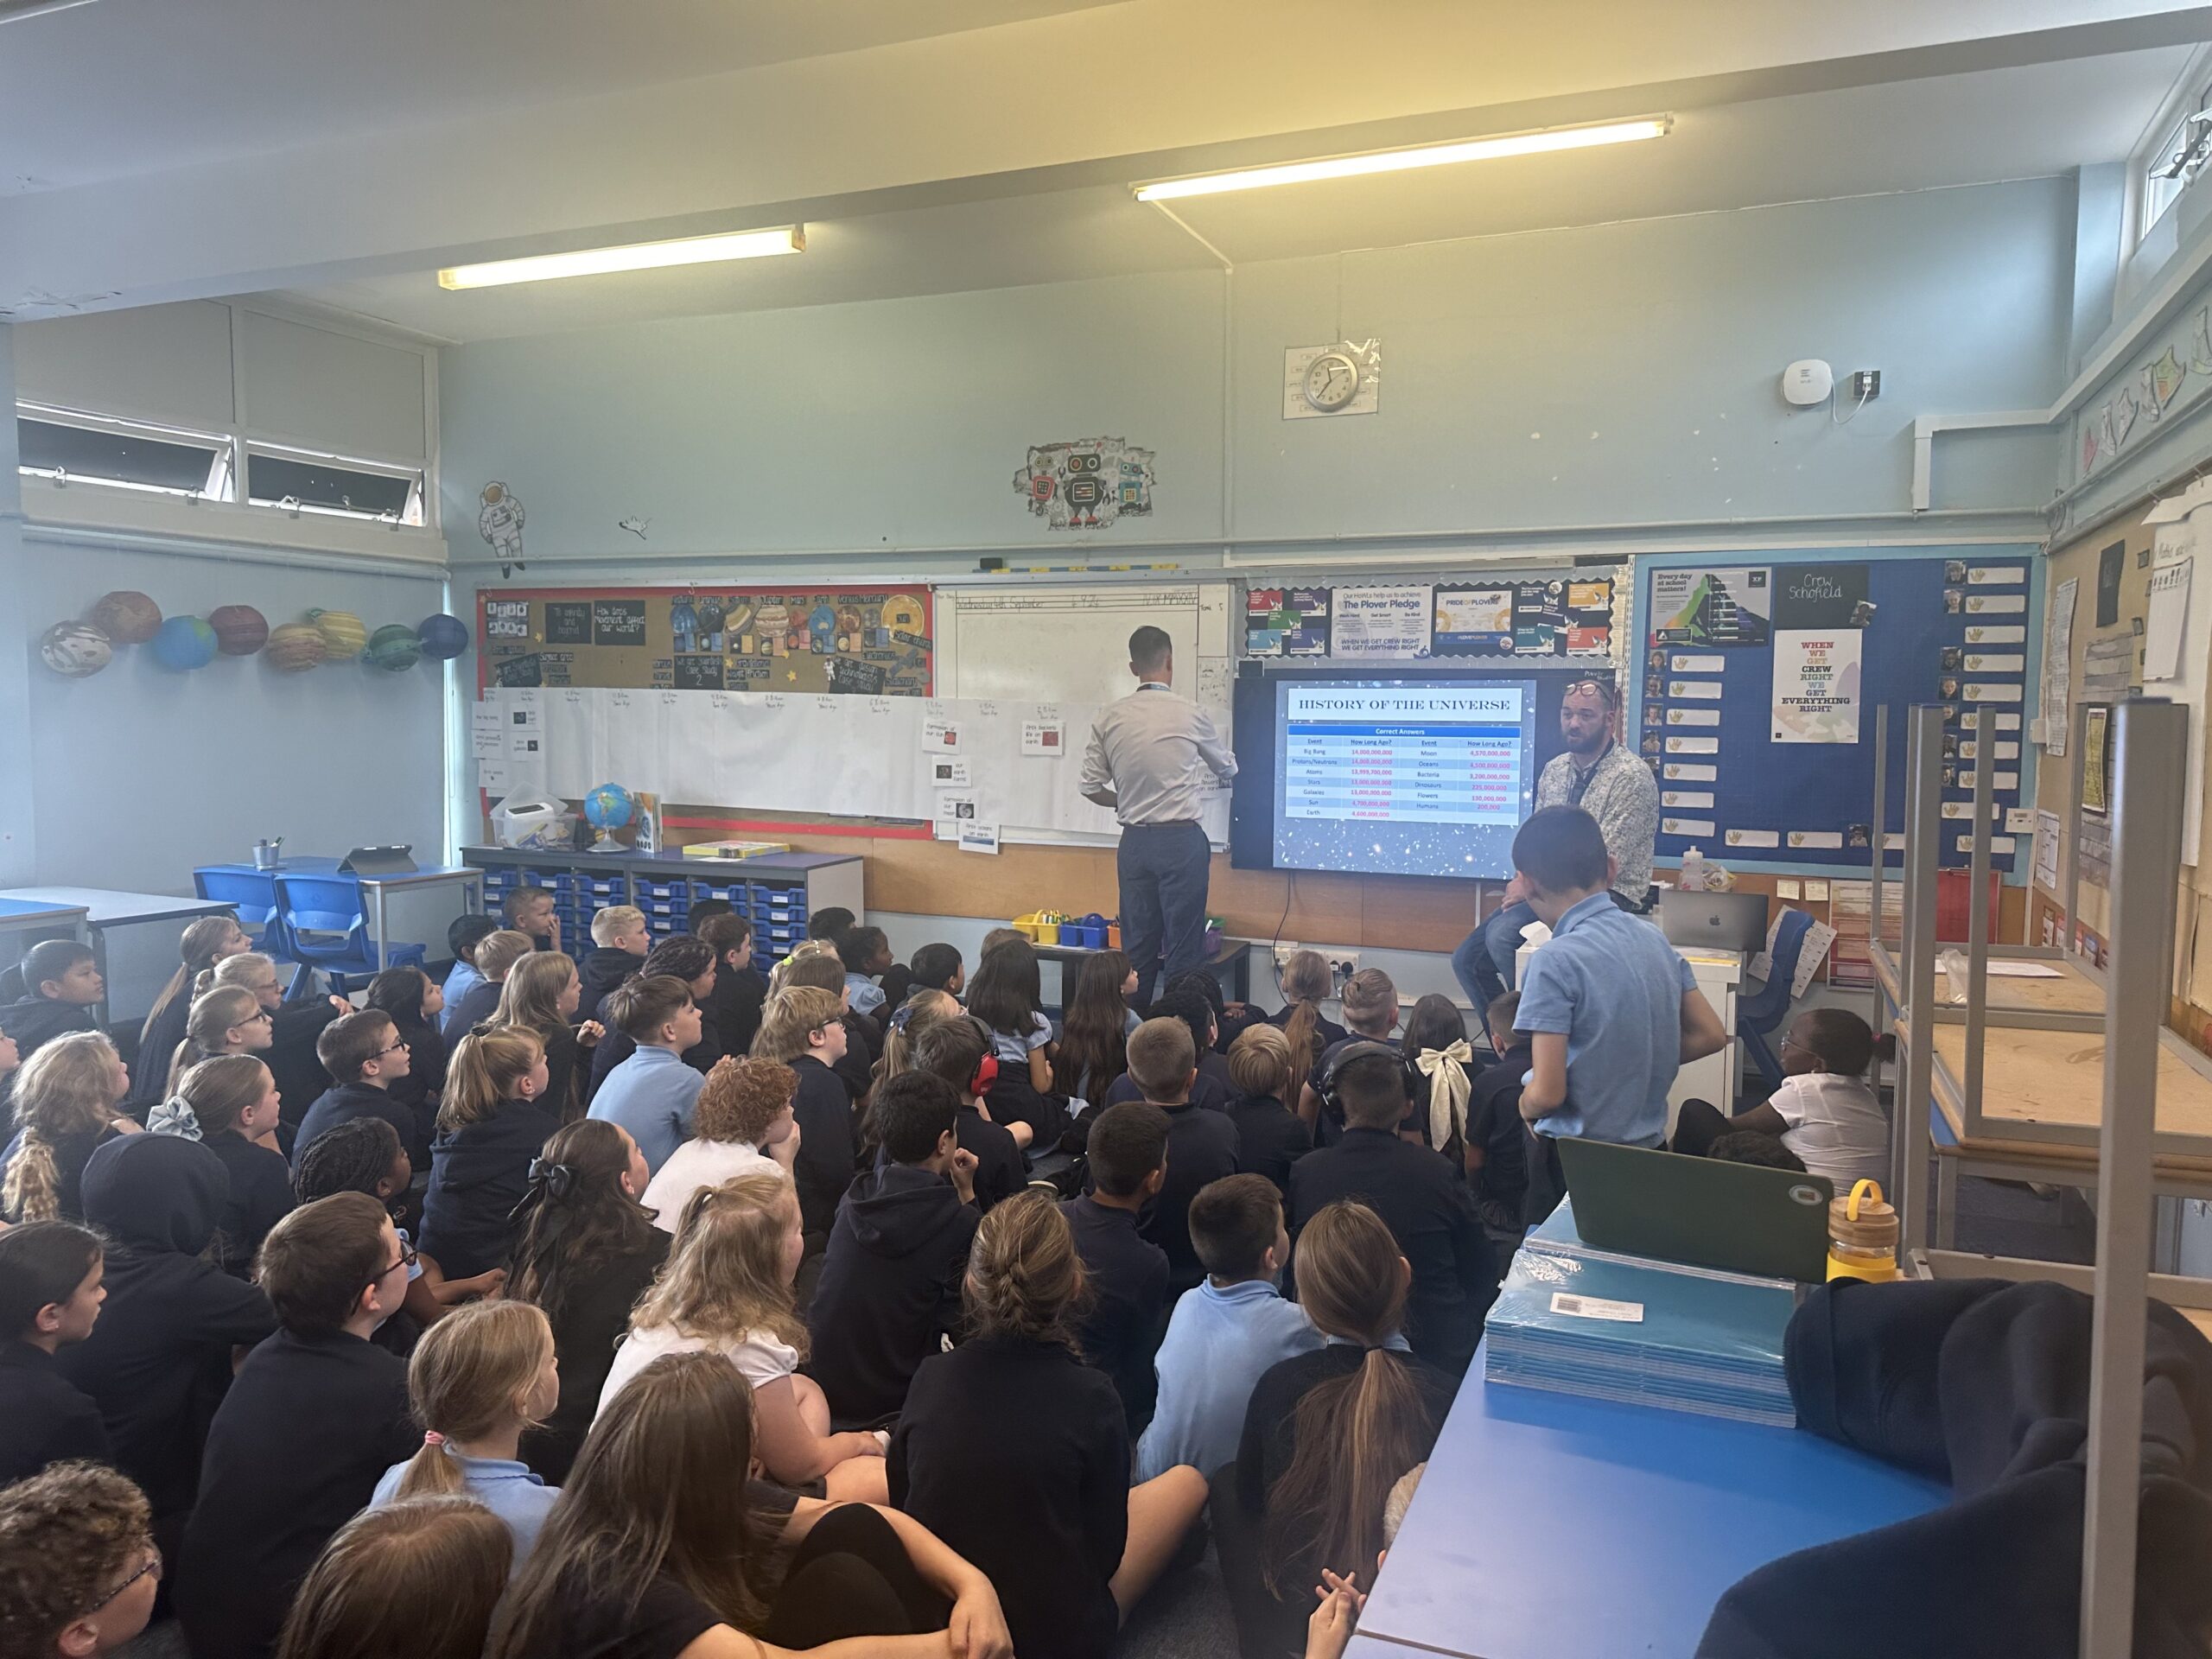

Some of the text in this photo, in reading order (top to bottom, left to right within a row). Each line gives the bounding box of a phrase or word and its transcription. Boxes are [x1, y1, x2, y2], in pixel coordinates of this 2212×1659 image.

[791, 596, 805, 605] Mars
[838, 595, 859, 604] Venus
[860, 594, 888, 604] Mercury
[1344, 599, 1421, 610] The Plover Pledge
[696, 675, 702, 686] 2
[1299, 700, 1510, 710] HISTORY OF THE UNIVERSE
